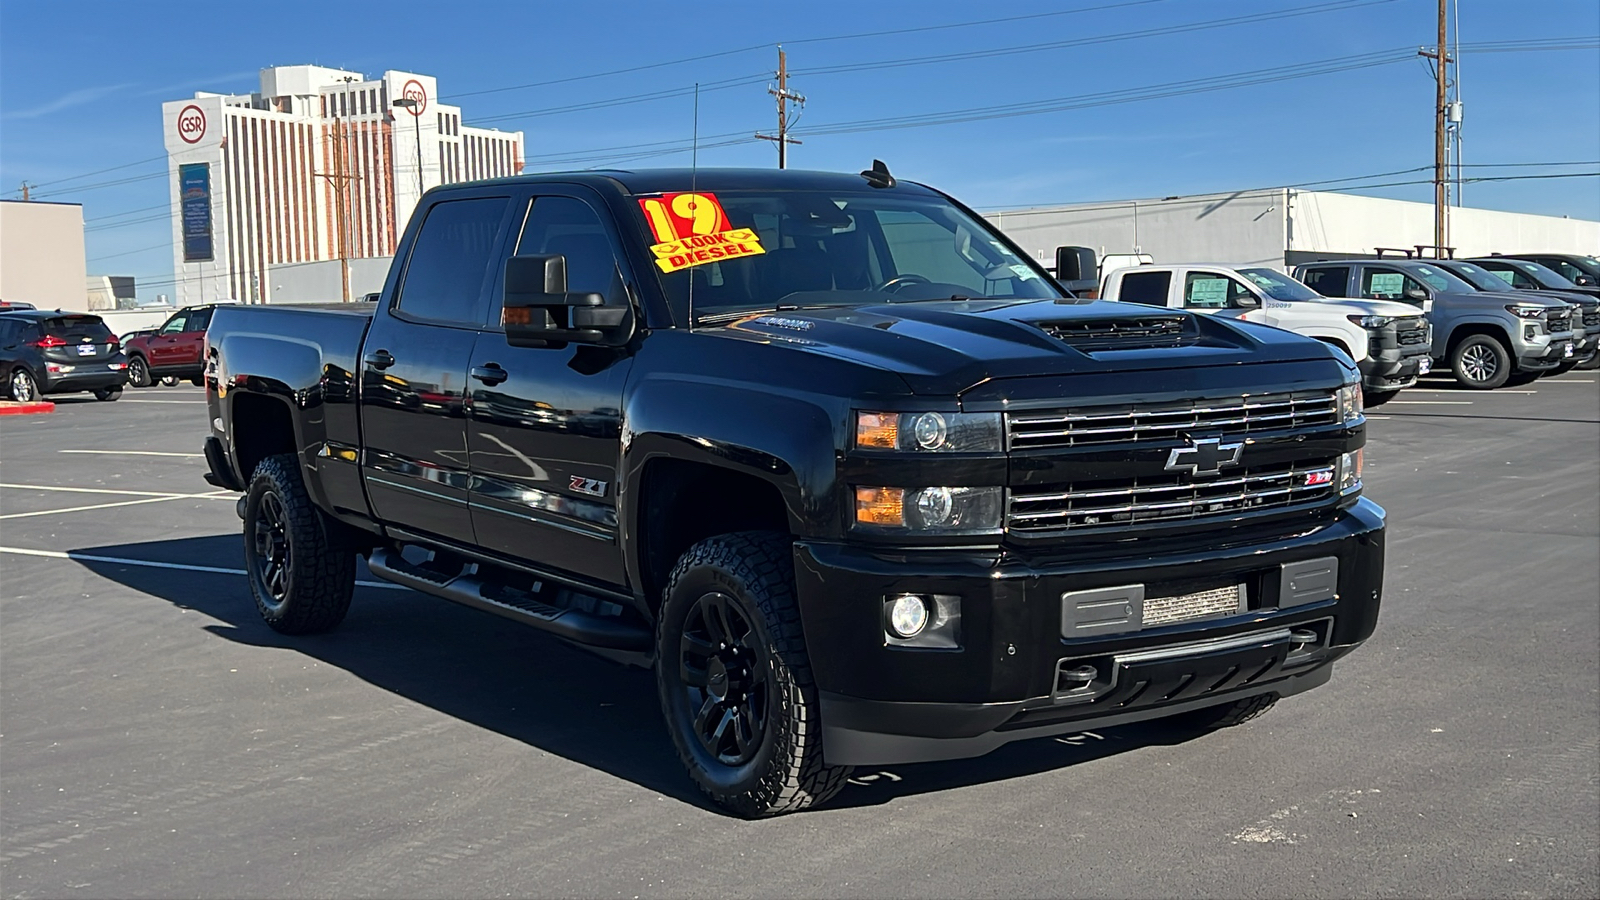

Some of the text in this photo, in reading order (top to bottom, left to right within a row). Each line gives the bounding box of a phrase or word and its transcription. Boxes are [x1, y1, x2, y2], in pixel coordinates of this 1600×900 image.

[405, 89, 424, 107] GSR
[181, 116, 202, 133] GSR
[645, 193, 722, 242] 19
[681, 233, 729, 250] LOOK
[668, 243, 753, 268] DIESEL
[569, 475, 608, 498] Z71
